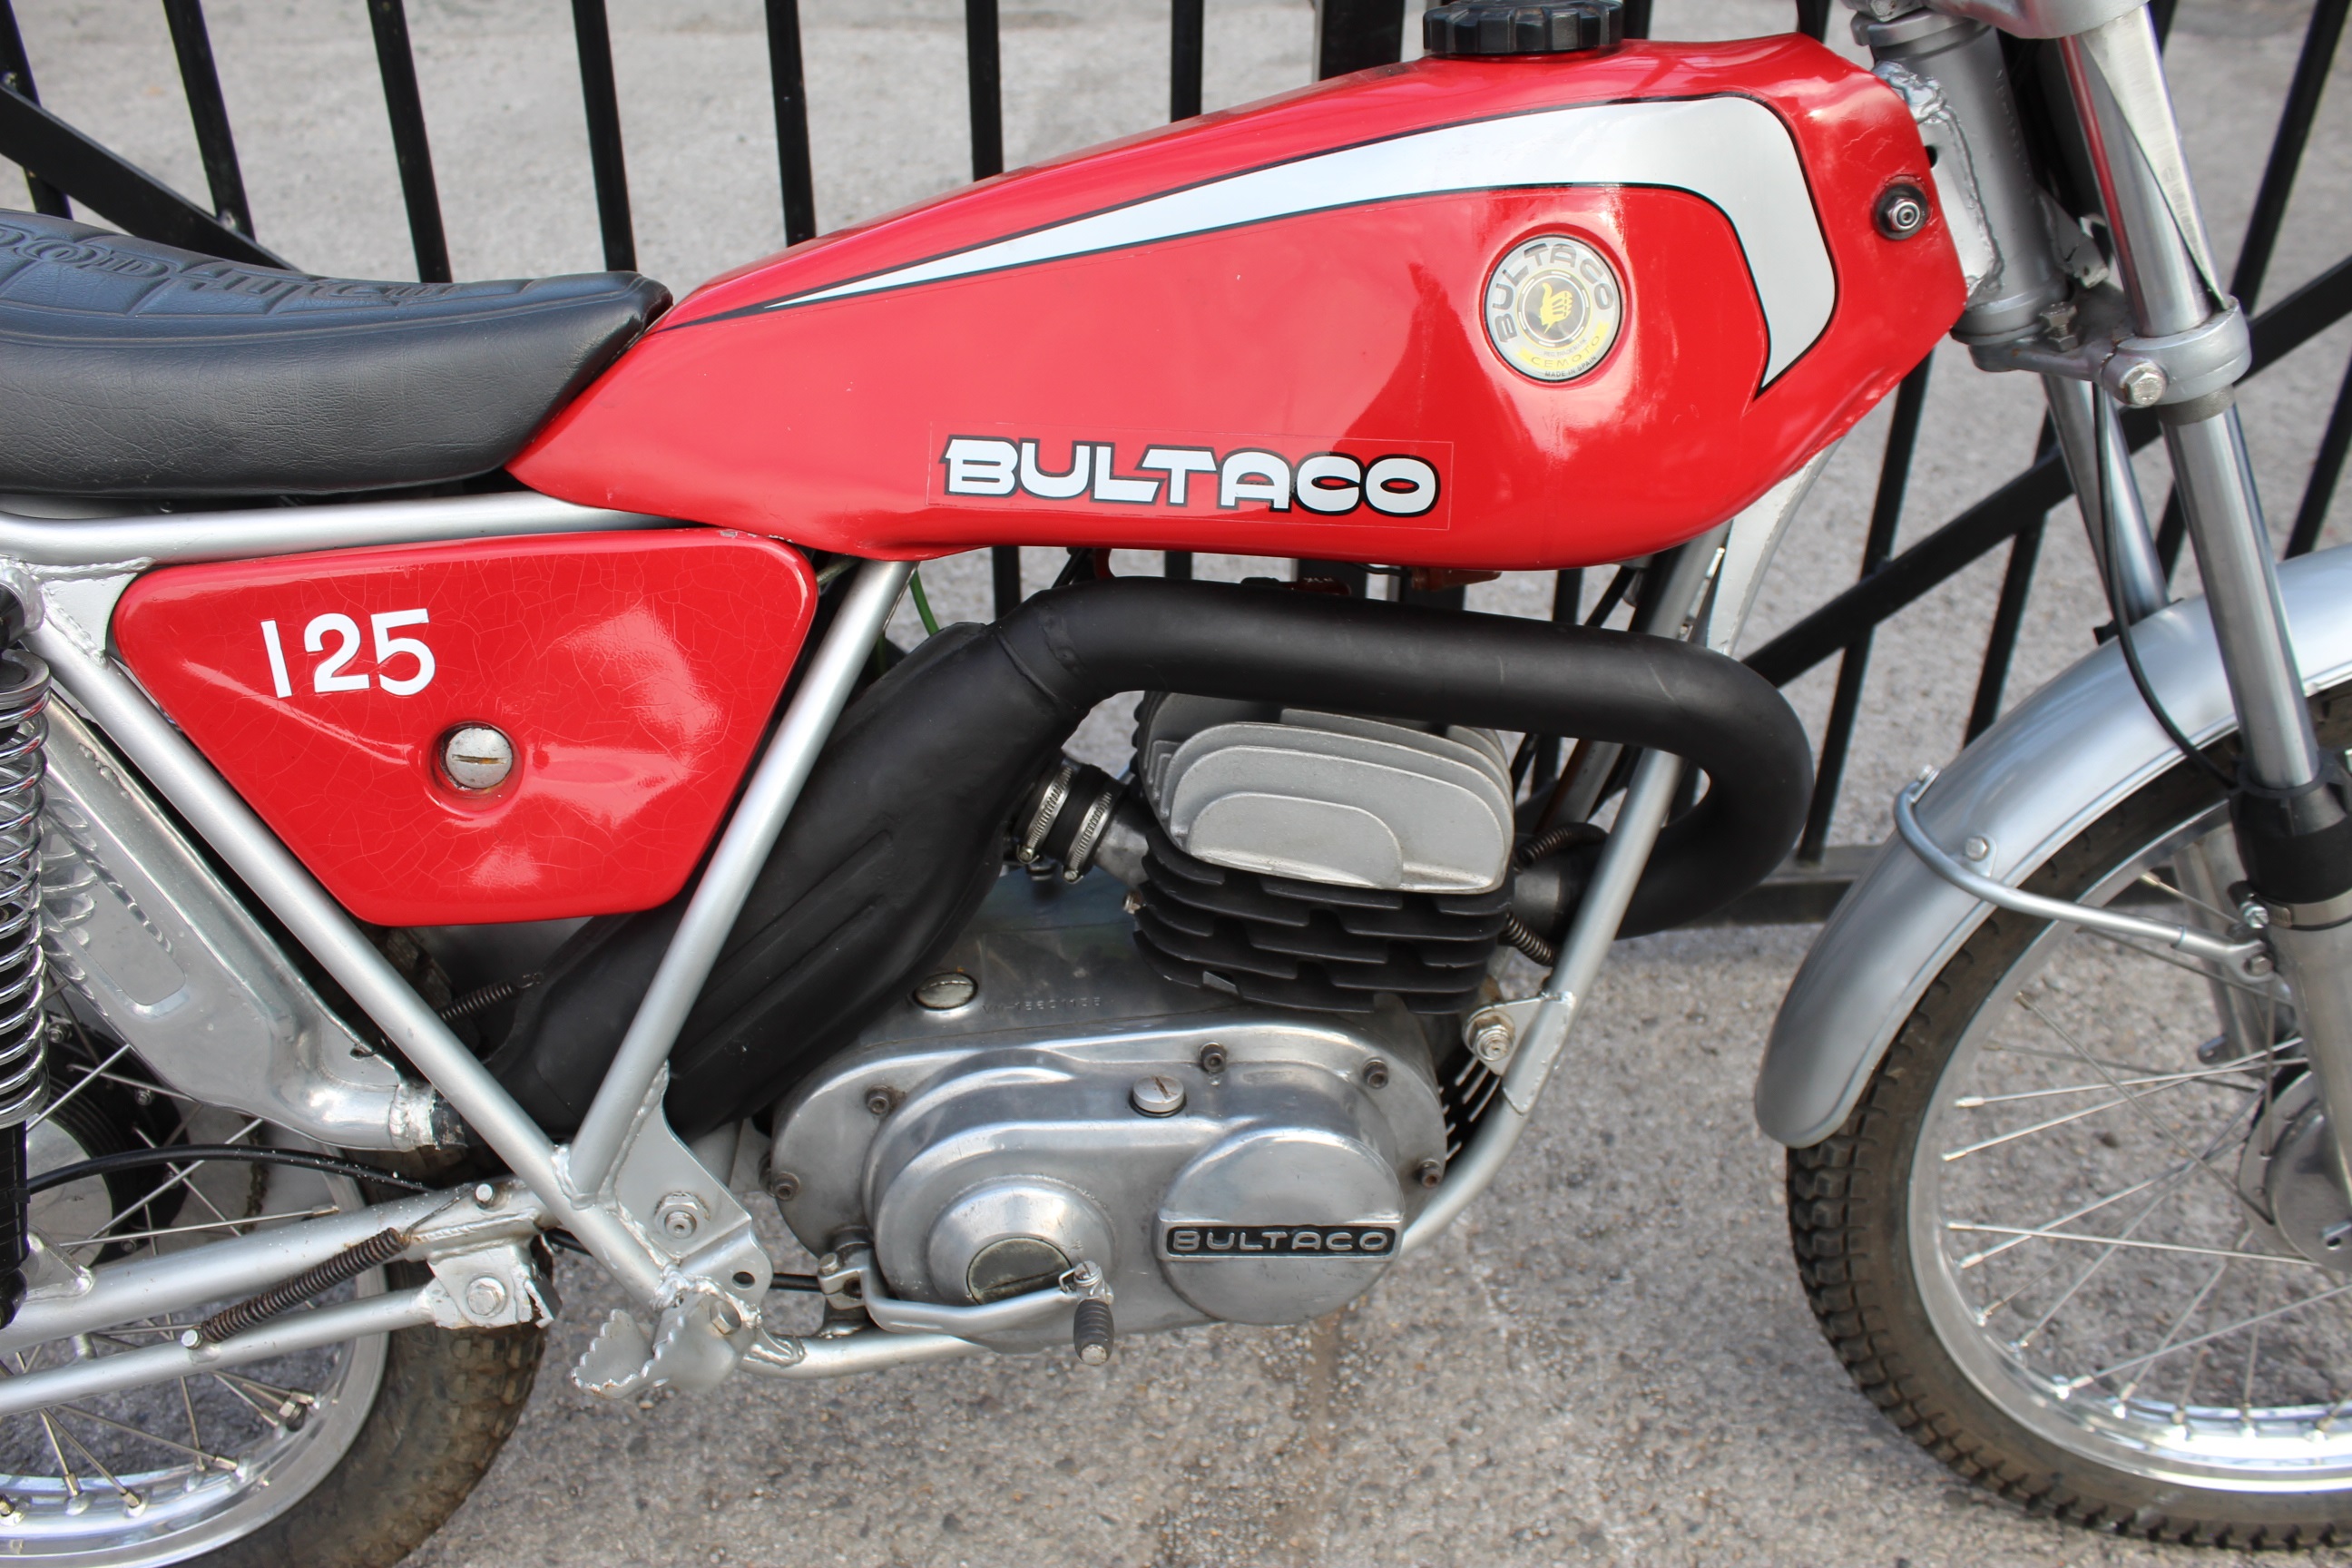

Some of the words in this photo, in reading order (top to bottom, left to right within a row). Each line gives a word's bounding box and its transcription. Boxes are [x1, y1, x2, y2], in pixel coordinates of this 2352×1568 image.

[1492, 242, 1614, 343] BULTACO
[1531, 335, 1600, 368] CEMOTO
[1568, 367, 1576, 376] IN
[1577, 355, 1597, 372] SPAIN
[940, 435, 1440, 516] BULTACO
[260, 608, 436, 699] 125
[1171, 1230, 1388, 1251] BULTACO
